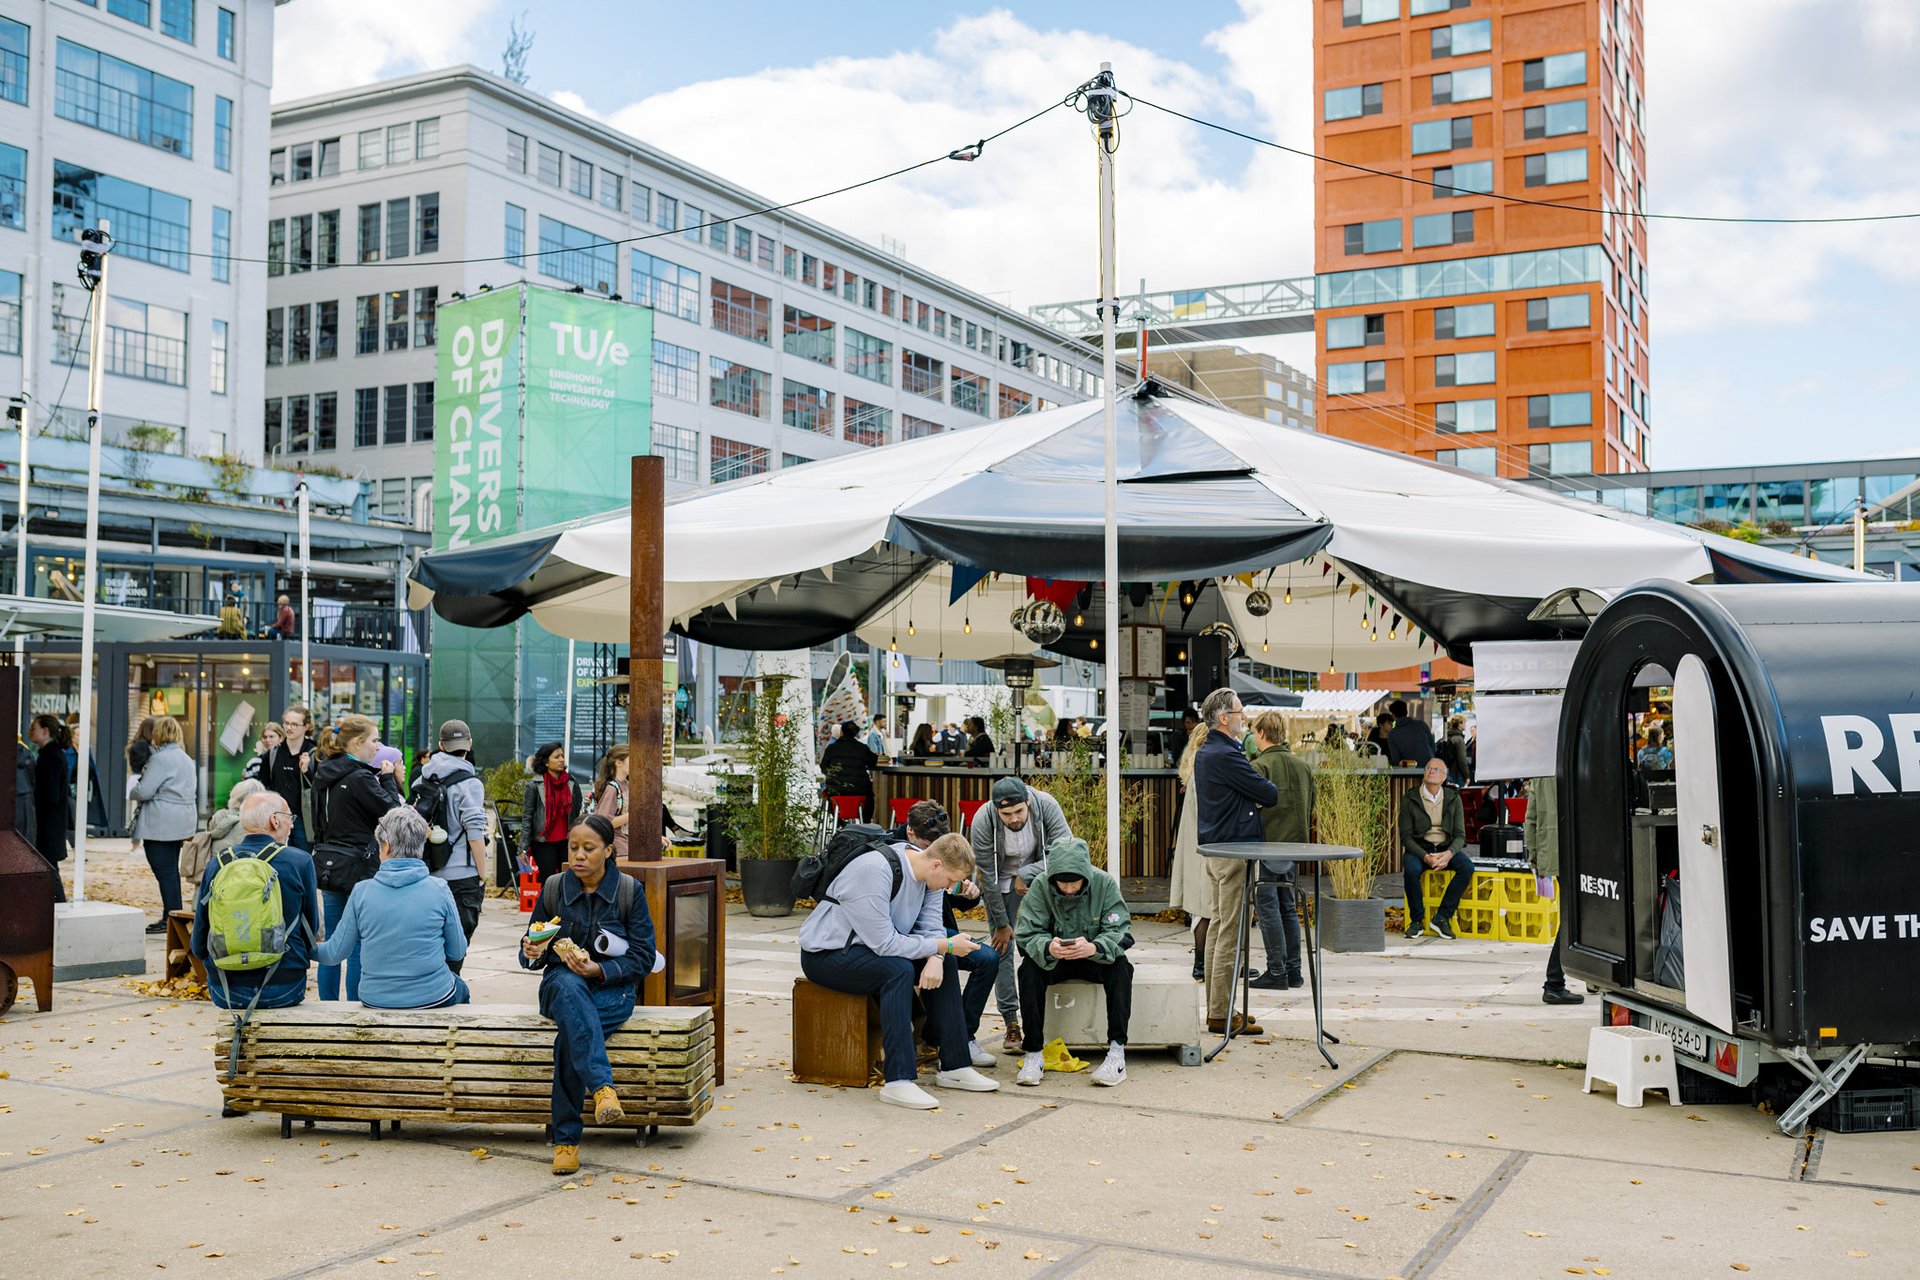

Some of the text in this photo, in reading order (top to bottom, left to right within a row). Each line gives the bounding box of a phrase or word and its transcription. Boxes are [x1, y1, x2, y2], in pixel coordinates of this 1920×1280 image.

[549, 321, 630, 369] TU/e
[451, 325, 475, 394] OF
[548, 368, 604, 385] EINDHOVEN
[548, 380, 616, 399] UNIVERSITY OF
[548, 392, 610, 410] TECHNOLOGY
[477, 318, 504, 533] DRIVERS
[104, 578, 138, 588] DESGN
[104, 586, 148, 597] THIKING
[576, 667, 618, 678] OF CHN
[1810, 915, 1887, 943] SAVE
